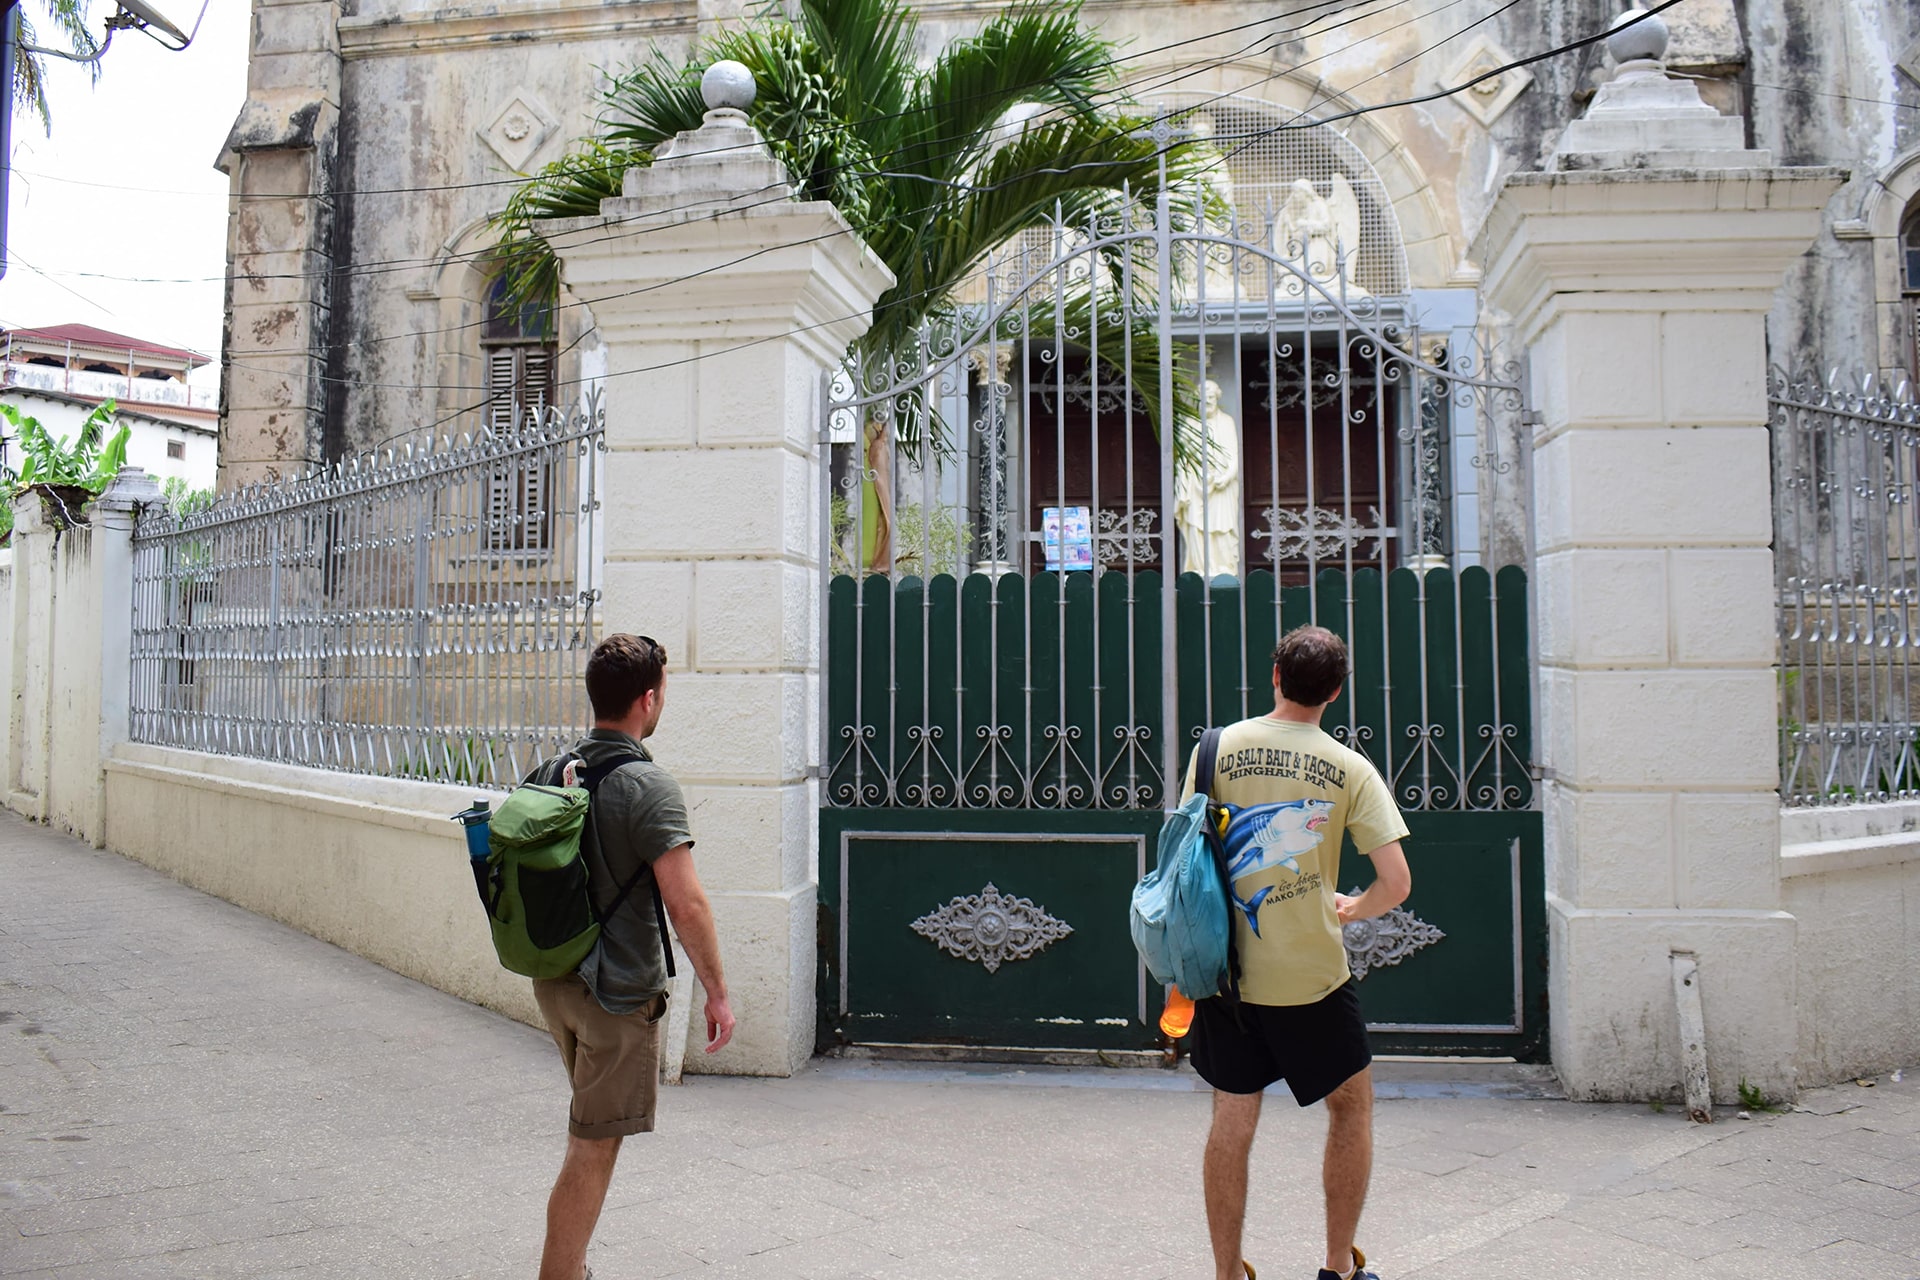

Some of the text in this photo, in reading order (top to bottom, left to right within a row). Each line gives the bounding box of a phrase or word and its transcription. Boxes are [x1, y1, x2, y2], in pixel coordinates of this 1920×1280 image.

[1218, 747, 1346, 790] LD SALT BAIT & TACKLE
[1303, 772, 1327, 790] MA
[1265, 890, 1294, 906] MAKO
